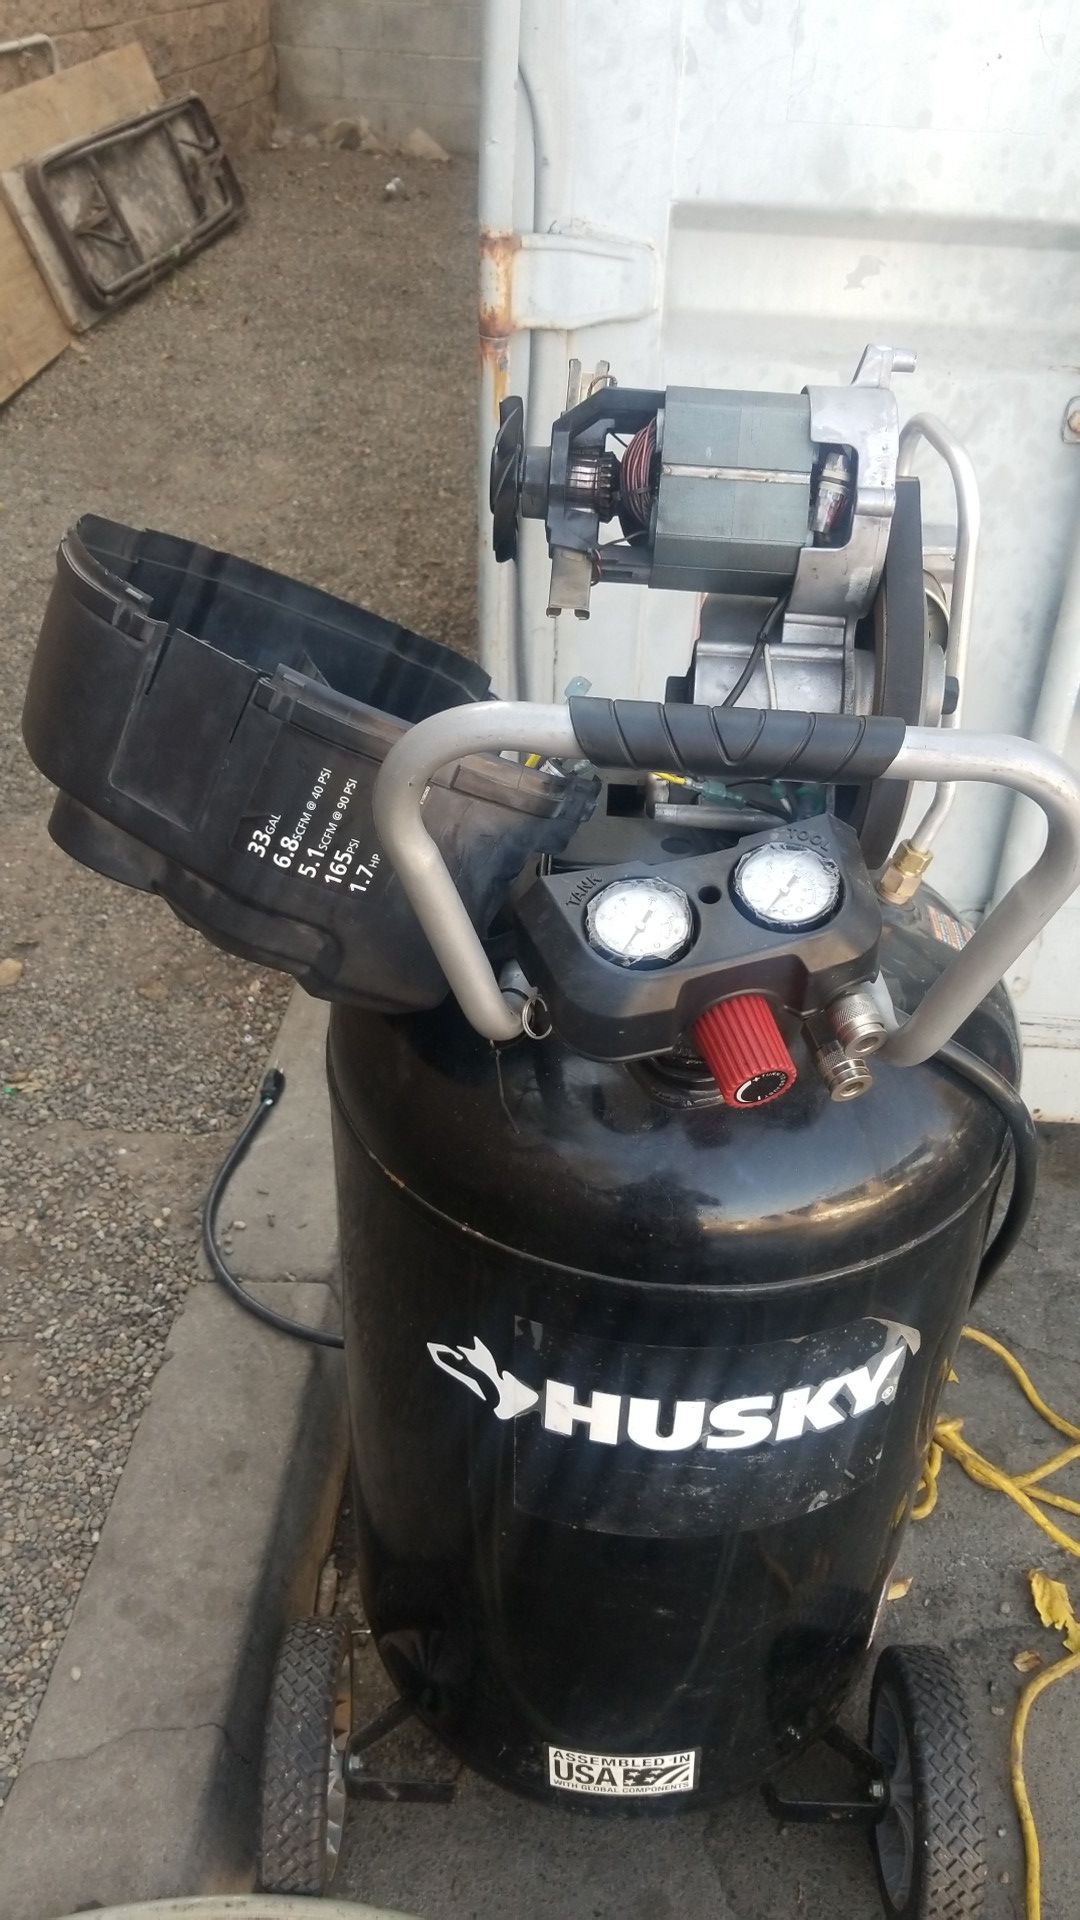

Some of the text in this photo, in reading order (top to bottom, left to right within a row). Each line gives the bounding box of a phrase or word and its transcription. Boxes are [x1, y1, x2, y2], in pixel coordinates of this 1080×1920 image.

[317, 767, 333, 785] PSI
[311, 785, 324, 800] 40
[343, 777, 358, 796] PSI
[306, 800, 317, 811] @
[336, 795, 351, 810] 90
[332, 810, 343, 822] @
[786, 826, 831, 852] TOOL
[349, 853, 381, 892] 1.7 HP
[565, 871, 603, 907] TANK
[544, 1345, 906, 1452] HUSKY
[553, 1750, 691, 1767] ASSEMBLED IN
[554, 1759, 618, 1787] USA
[554, 1779, 690, 1793] WITH GLOBAL COMPONENTS
